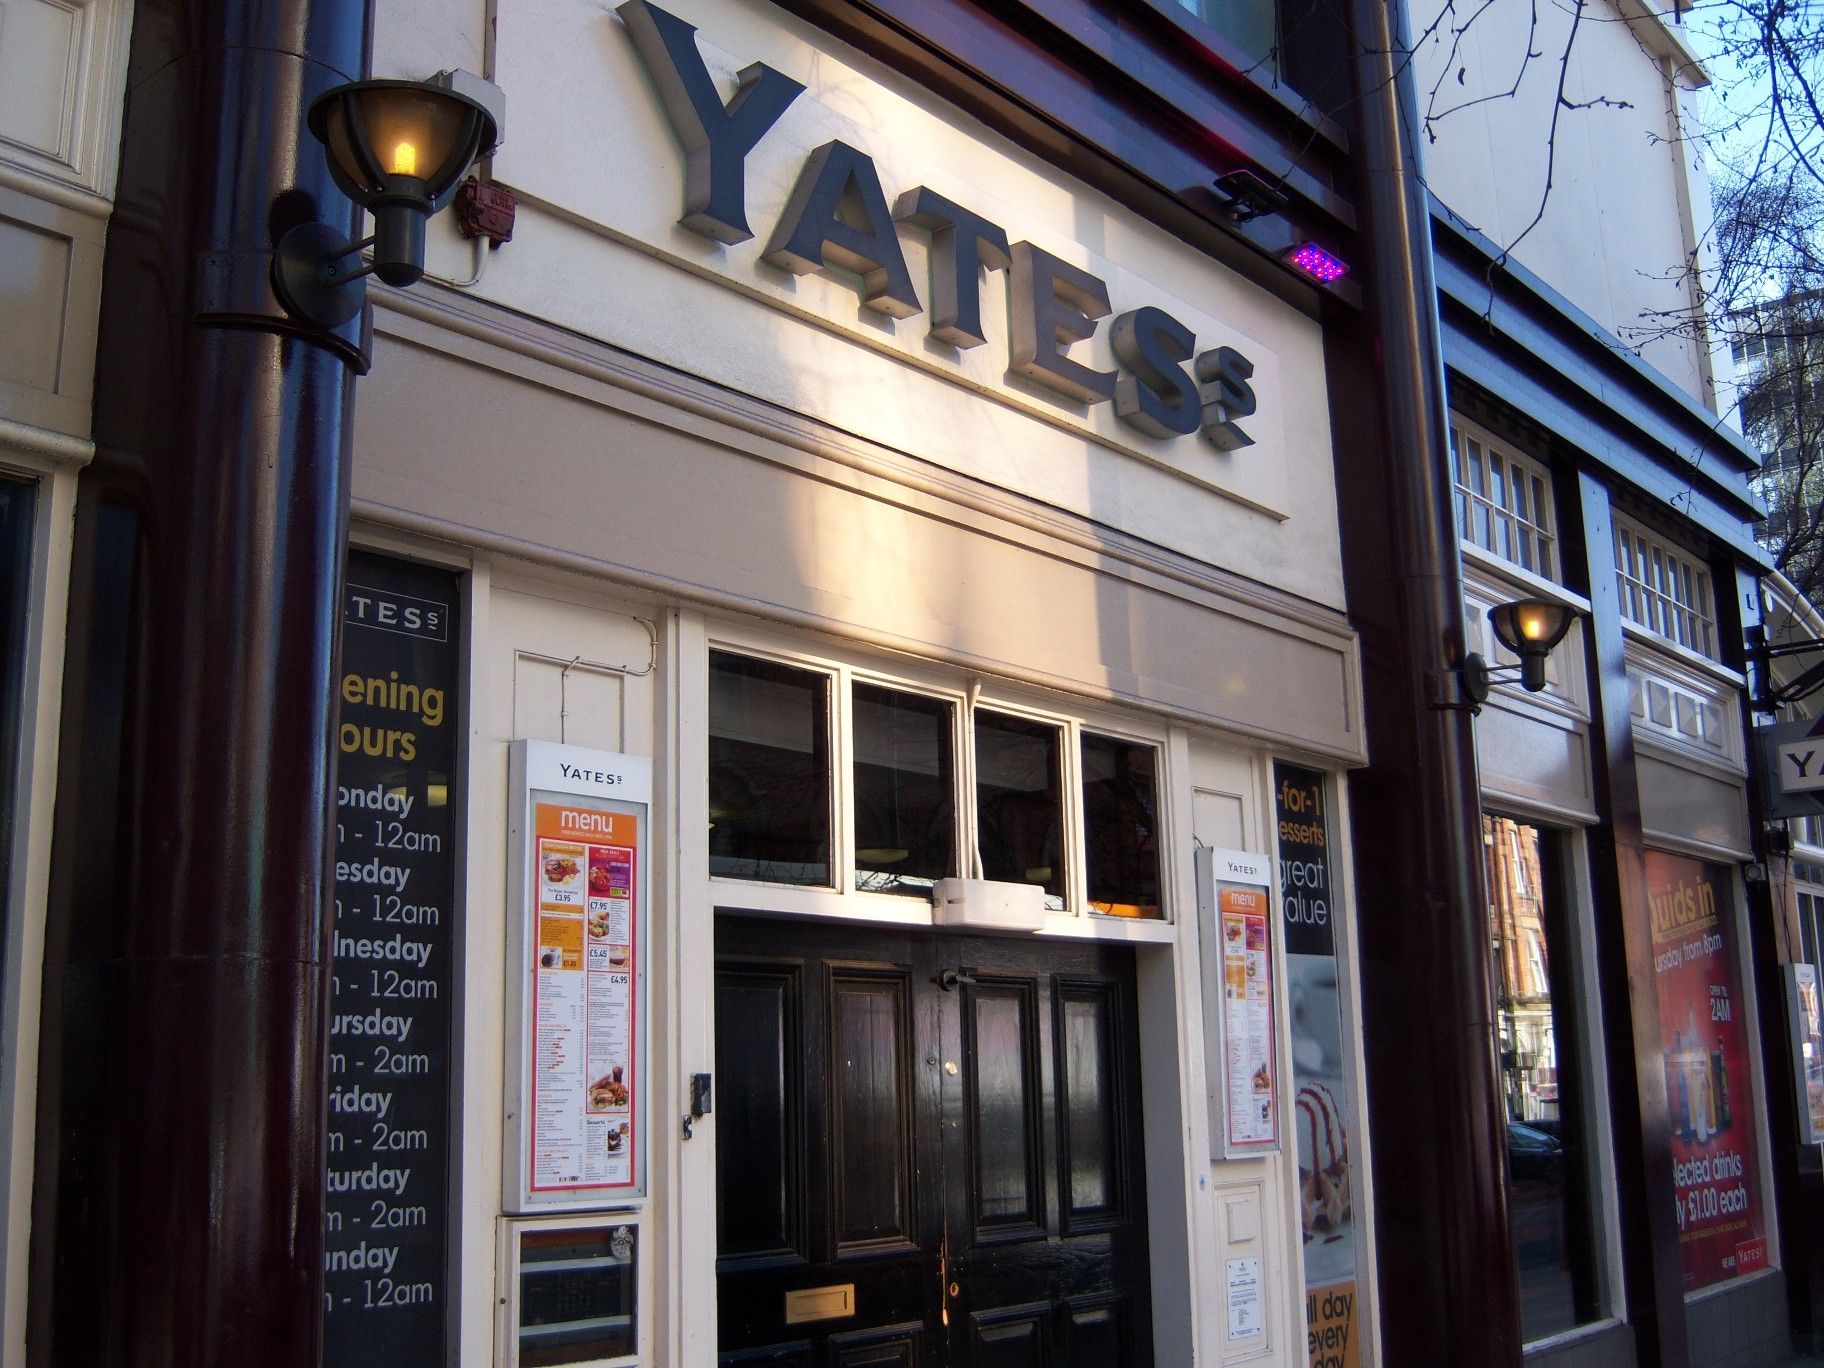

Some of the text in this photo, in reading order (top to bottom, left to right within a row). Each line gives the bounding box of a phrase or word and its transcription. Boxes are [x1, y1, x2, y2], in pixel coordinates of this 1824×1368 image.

[1786, 750, 1824, 778] Y
[561, 810, 613, 833] menu
[375, 820, 441, 853] 12am
[373, 894, 440, 926] 12am
[590, 901, 608, 910] £7.95
[1231, 892, 1255, 907] menu
[1281, 890, 1328, 926] alue
[1696, 875, 1717, 916] in
[1683, 940, 1703, 962] from
[1703, 933, 1722, 957] 8pm
[371, 969, 438, 999] 12am
[610, 975, 628, 985] £4.95
[1710, 998, 1731, 1021] 2AM
[374, 1045, 429, 1073] 2am
[372, 1122, 428, 1151] 2am
[1713, 1149, 1742, 1180] drinks
[371, 1199, 426, 1228] 2am
[1688, 1187, 1718, 1221] £1.00
[1720, 1181, 1748, 1214] each
[364, 1278, 433, 1309] 12am
[1322, 1290, 1353, 1322] day
[1308, 1322, 1350, 1355] every
